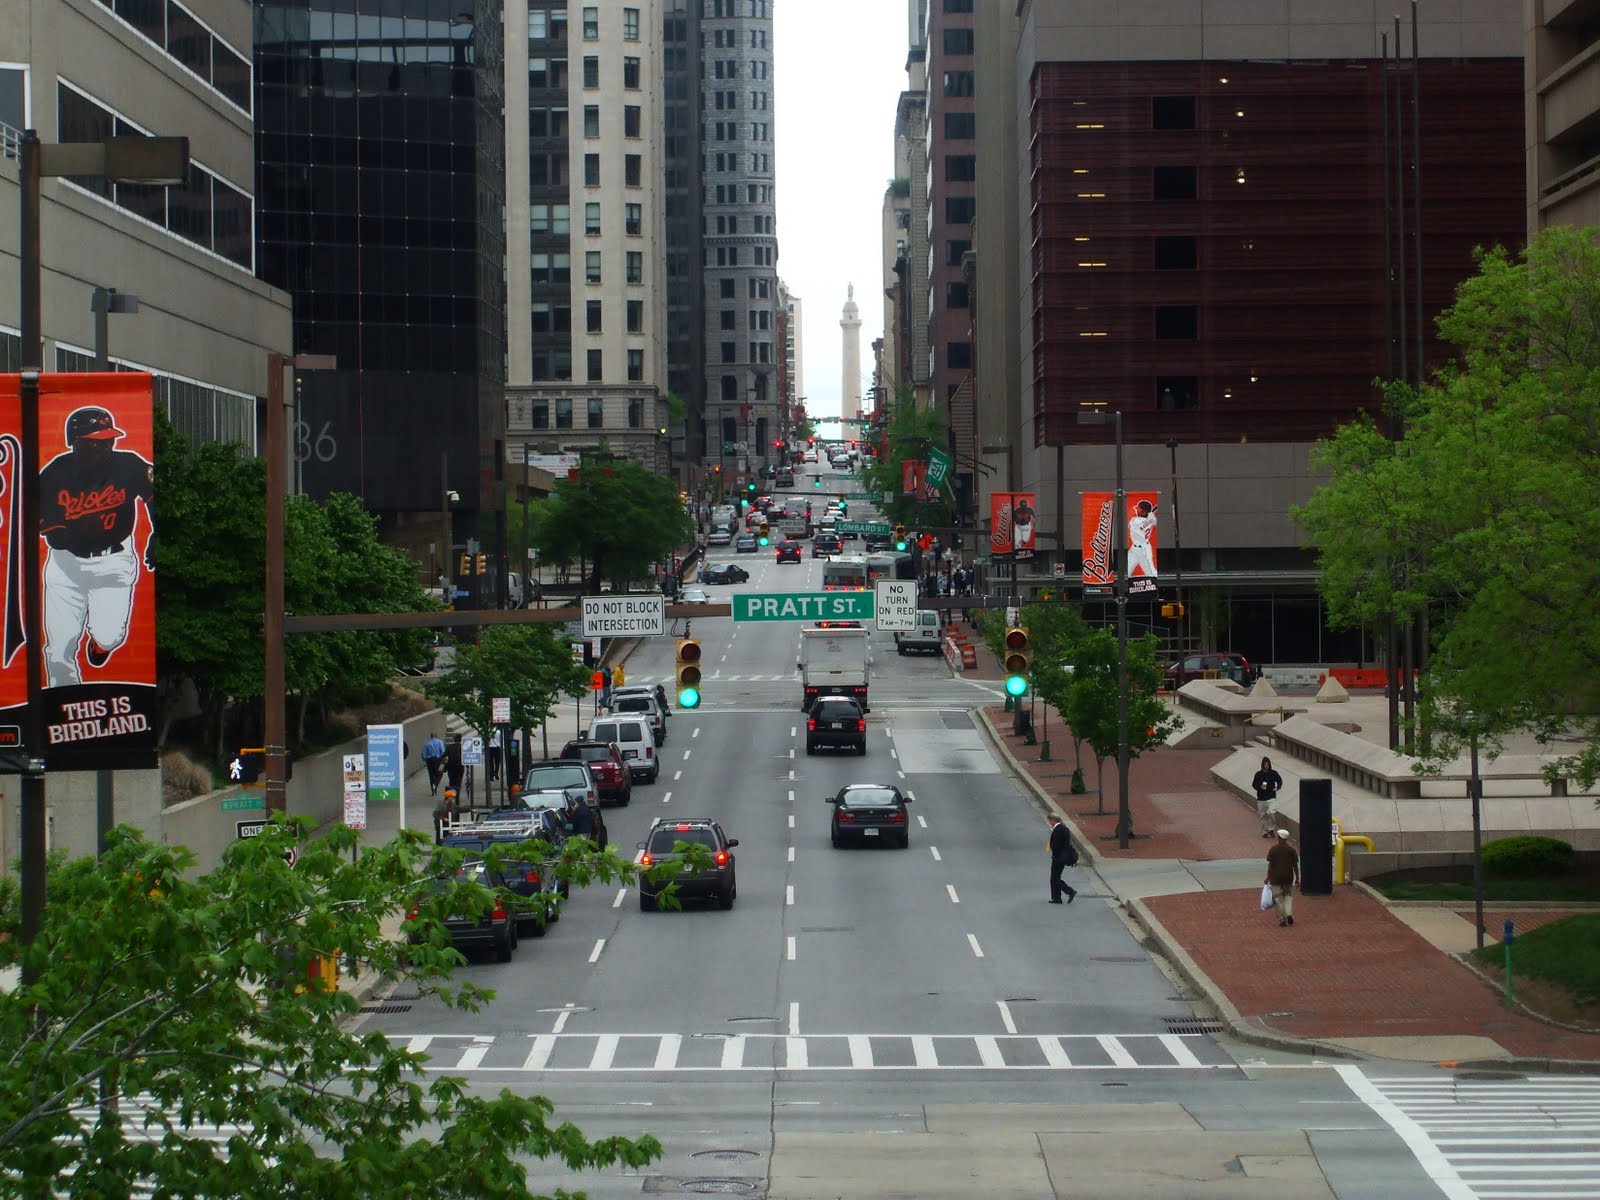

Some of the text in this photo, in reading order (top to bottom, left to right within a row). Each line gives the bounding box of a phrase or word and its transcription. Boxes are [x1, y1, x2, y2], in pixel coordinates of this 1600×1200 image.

[839, 524, 876, 532] LOMBARD
[1083, 501, 1113, 583] Baltimore
[890, 585, 904, 593] NO
[885, 596, 908, 604] TURN
[585, 601, 660, 614] DO NOT BLOCK
[748, 597, 861, 617] PRATT ST.
[879, 607, 914, 615] ON RED
[588, 618, 658, 631] INTERSECTION
[62, 696, 132, 721] THIS IS
[48, 713, 152, 744] BIRDLAND.
[229, 801, 252, 809] PRATT
[243, 827, 261, 836] ONE
